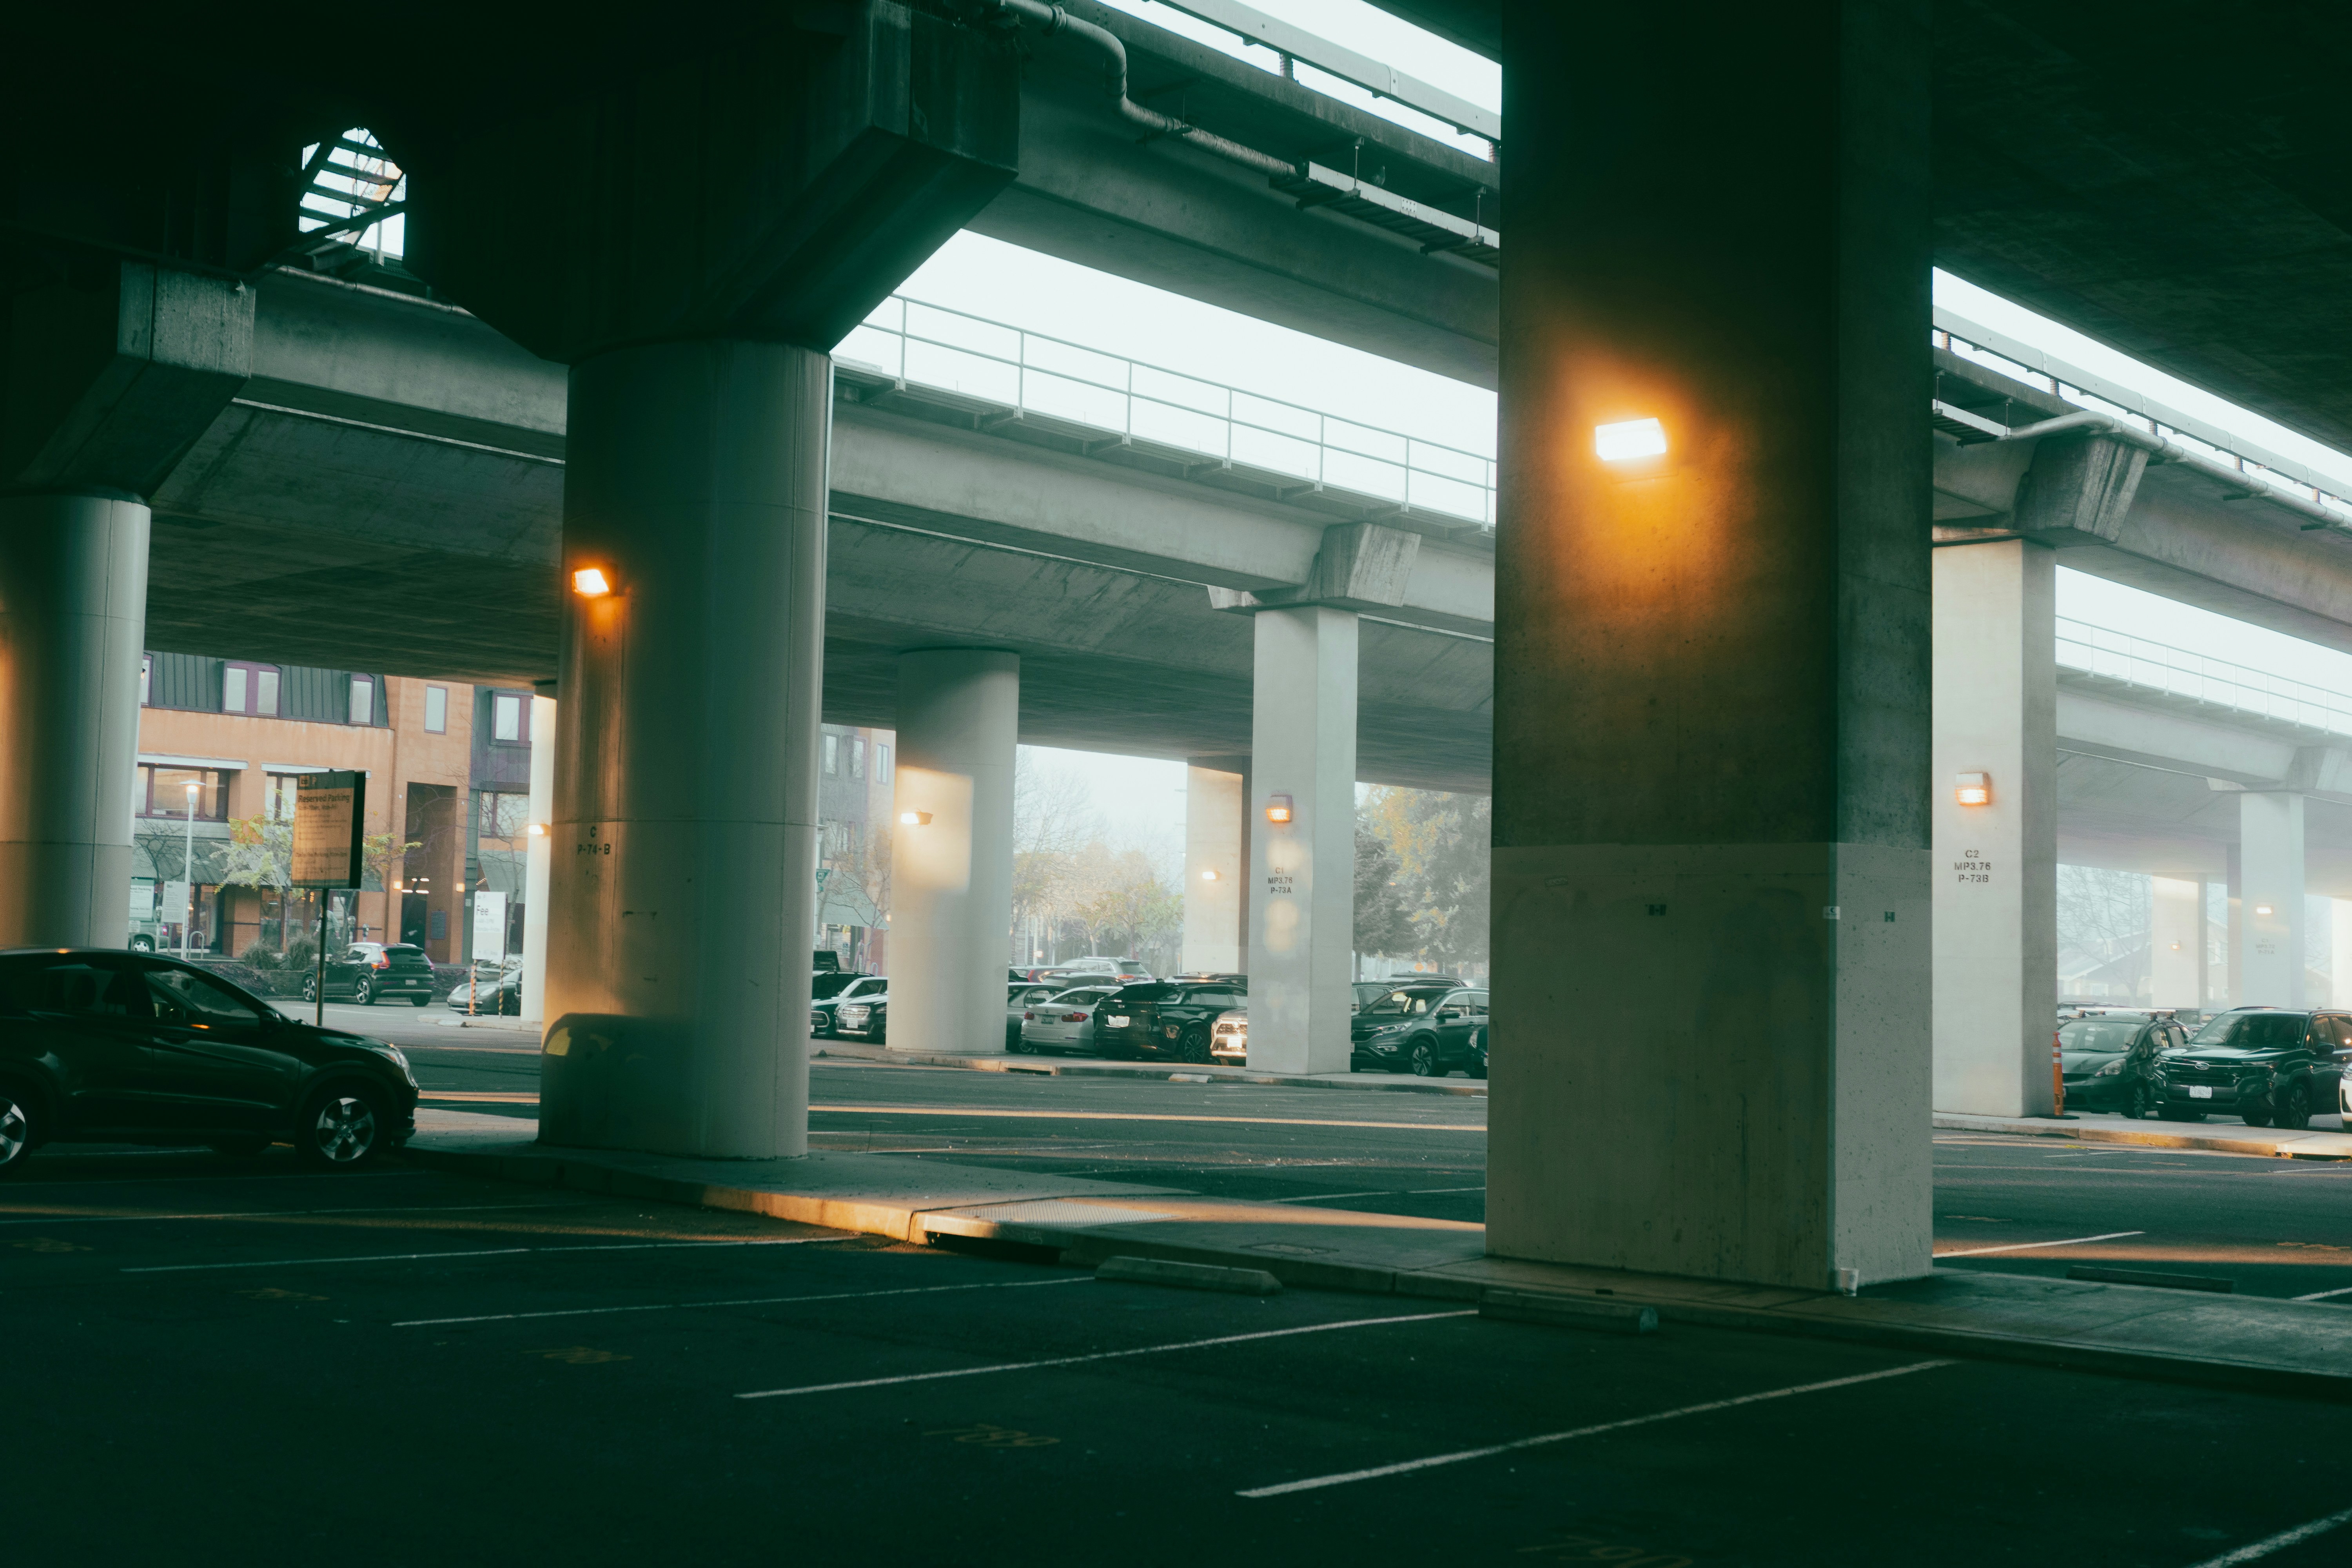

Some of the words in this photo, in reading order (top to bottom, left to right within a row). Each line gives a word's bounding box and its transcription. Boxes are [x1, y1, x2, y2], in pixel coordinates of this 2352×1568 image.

[298, 794, 327, 802] Reserved
[328, 793, 350, 803] Parking
[590, 826, 597, 838] C
[577, 843, 611, 855] P-74-B
[1965, 849, 1979, 858] C2
[1954, 862, 1991, 871] MP3.76
[1958, 874, 1989, 883] P-73B
[476, 905, 489, 916] Fee
